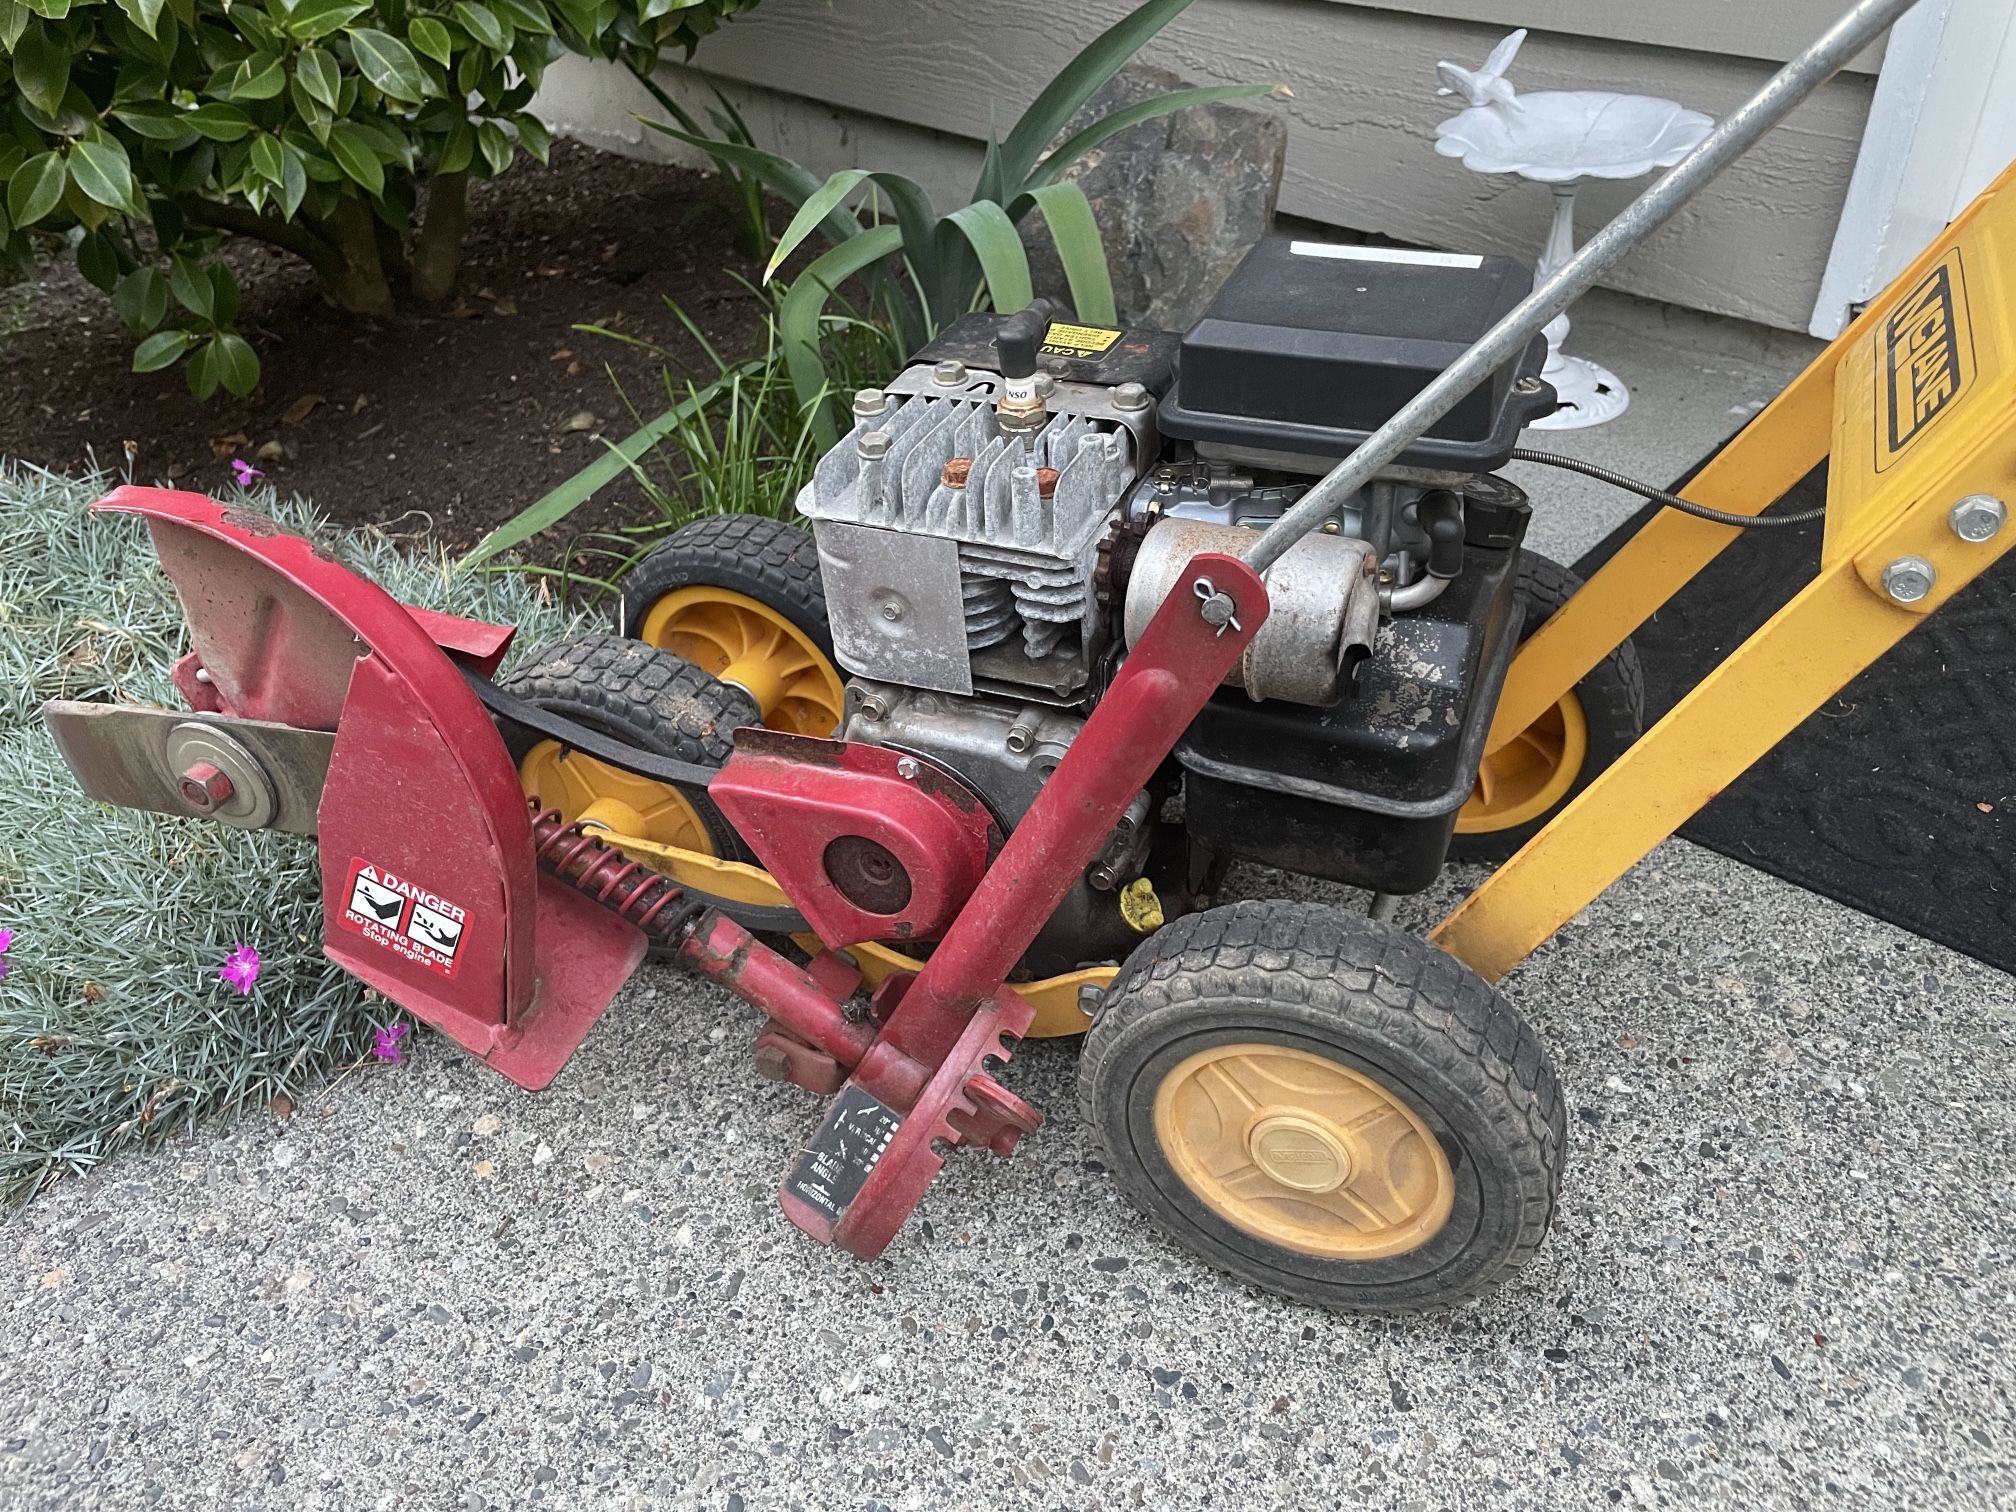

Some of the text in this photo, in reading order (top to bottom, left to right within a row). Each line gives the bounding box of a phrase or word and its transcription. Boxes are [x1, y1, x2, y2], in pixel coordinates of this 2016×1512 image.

[382, 873, 466, 924] DANGER
[345, 909, 454, 969] ROTATING BLADE
[362, 927, 432, 966] Stop engine
[810, 1161, 838, 1185] ANGLE
[796, 1180, 836, 1212] HORIZONTAL
